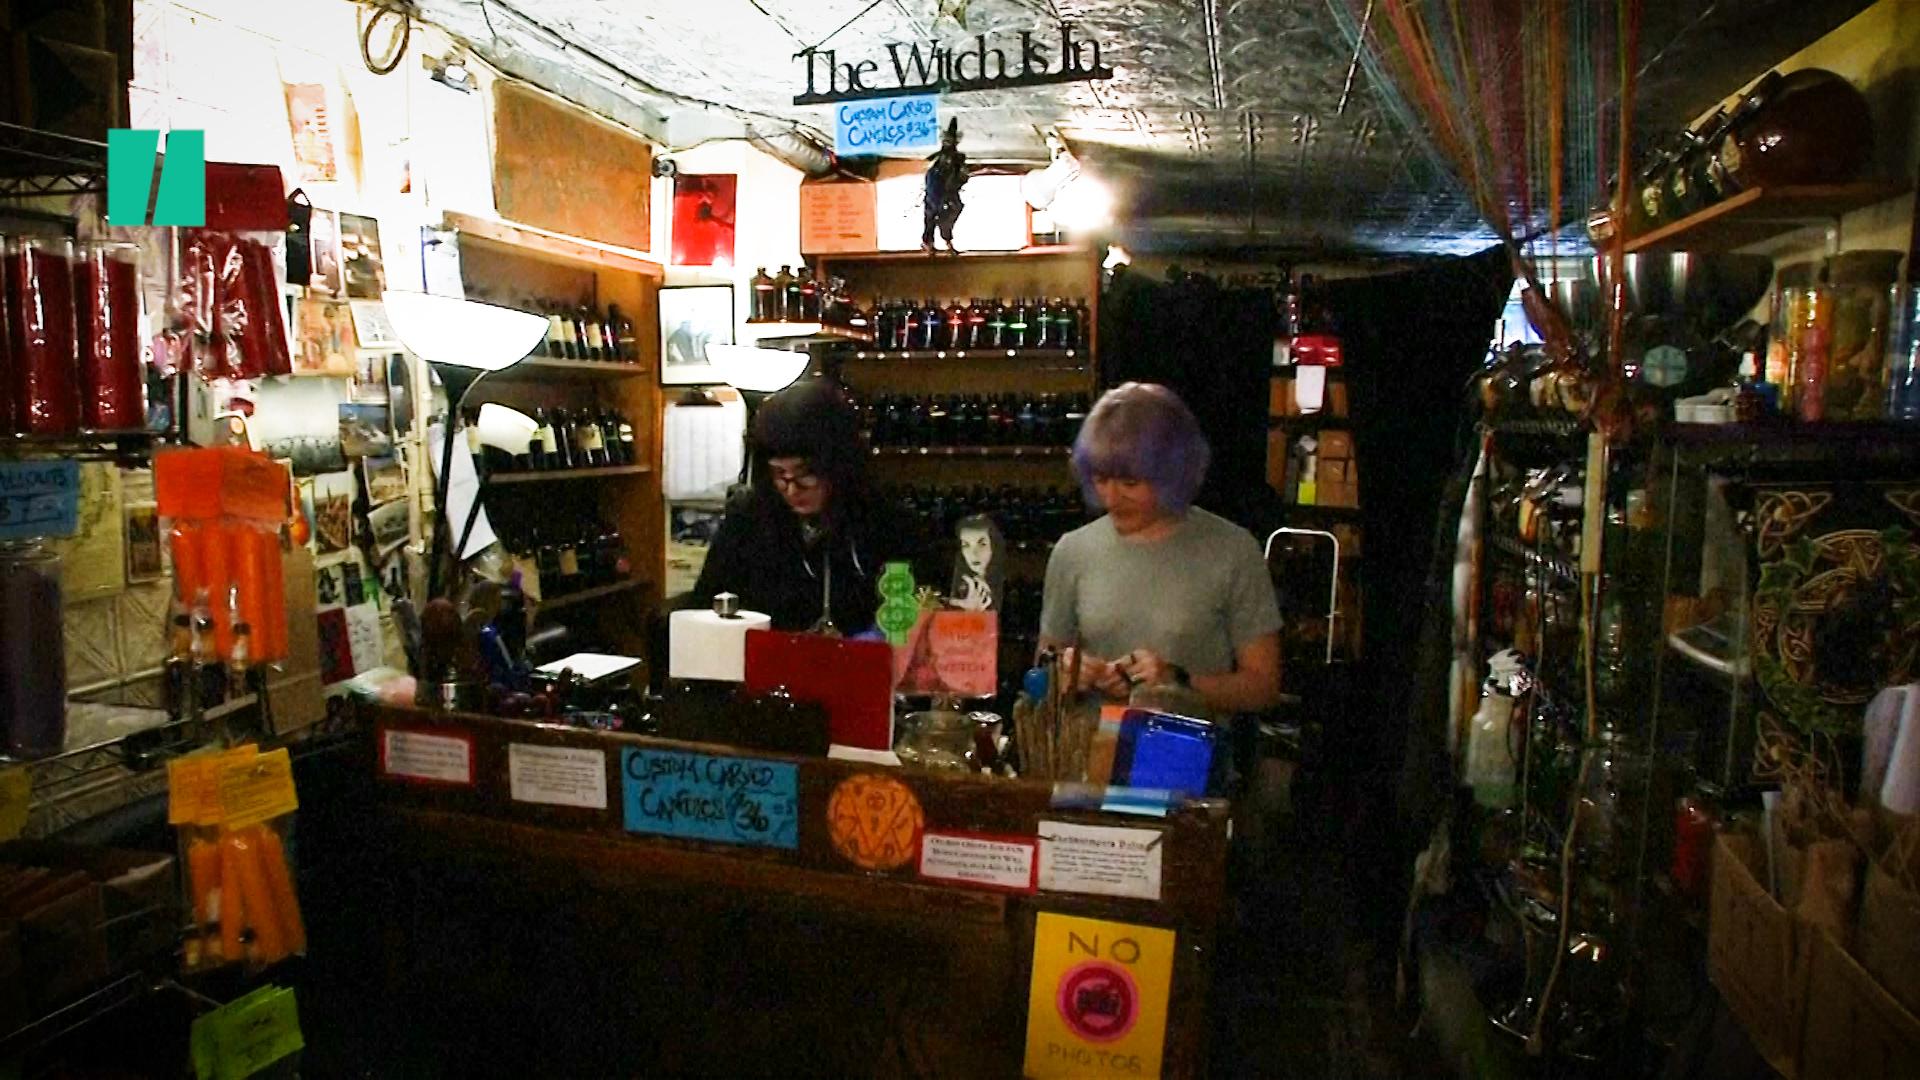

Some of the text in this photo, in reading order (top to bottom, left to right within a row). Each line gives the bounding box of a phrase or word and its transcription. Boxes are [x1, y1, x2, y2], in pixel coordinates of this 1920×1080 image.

[792, 20, 1101, 96] The Witch Is In
[1068, 931, 1140, 964] NO
